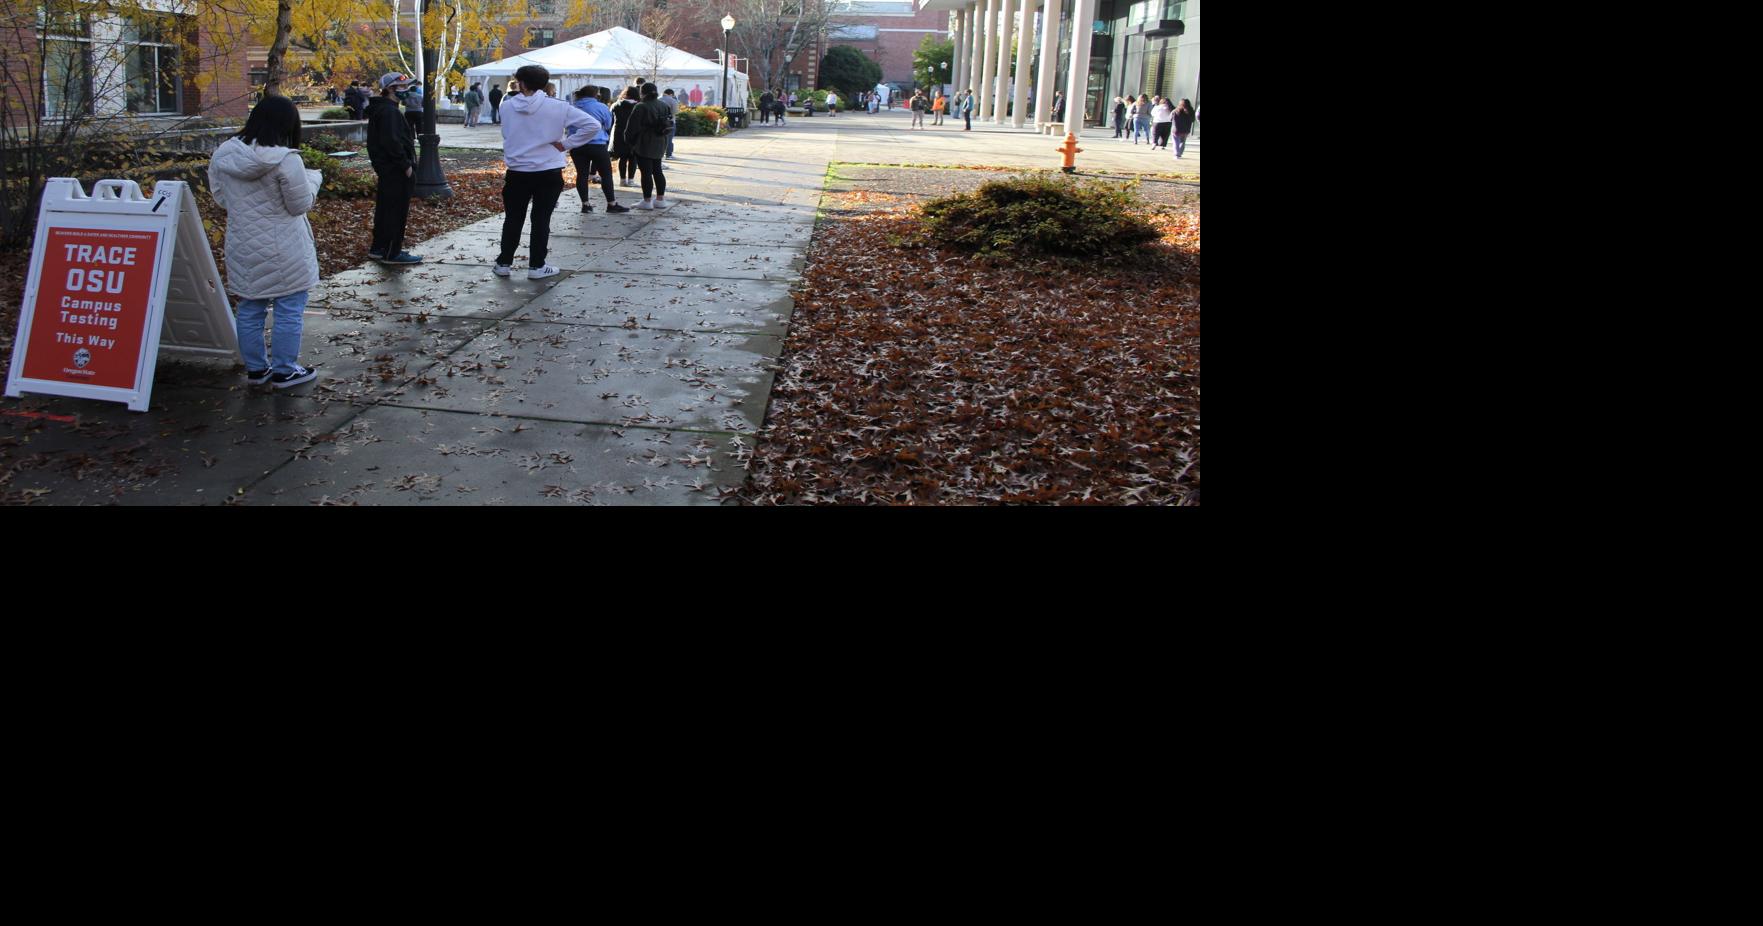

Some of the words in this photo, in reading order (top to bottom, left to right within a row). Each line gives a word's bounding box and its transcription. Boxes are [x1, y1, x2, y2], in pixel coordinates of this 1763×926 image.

[64, 244, 137, 265] TRACE
[66, 268, 125, 294] OSU
[61, 296, 122, 312] Campus
[60, 311, 118, 330] Testing
[56, 332, 84, 345] This
[88, 335, 115, 350] Way
